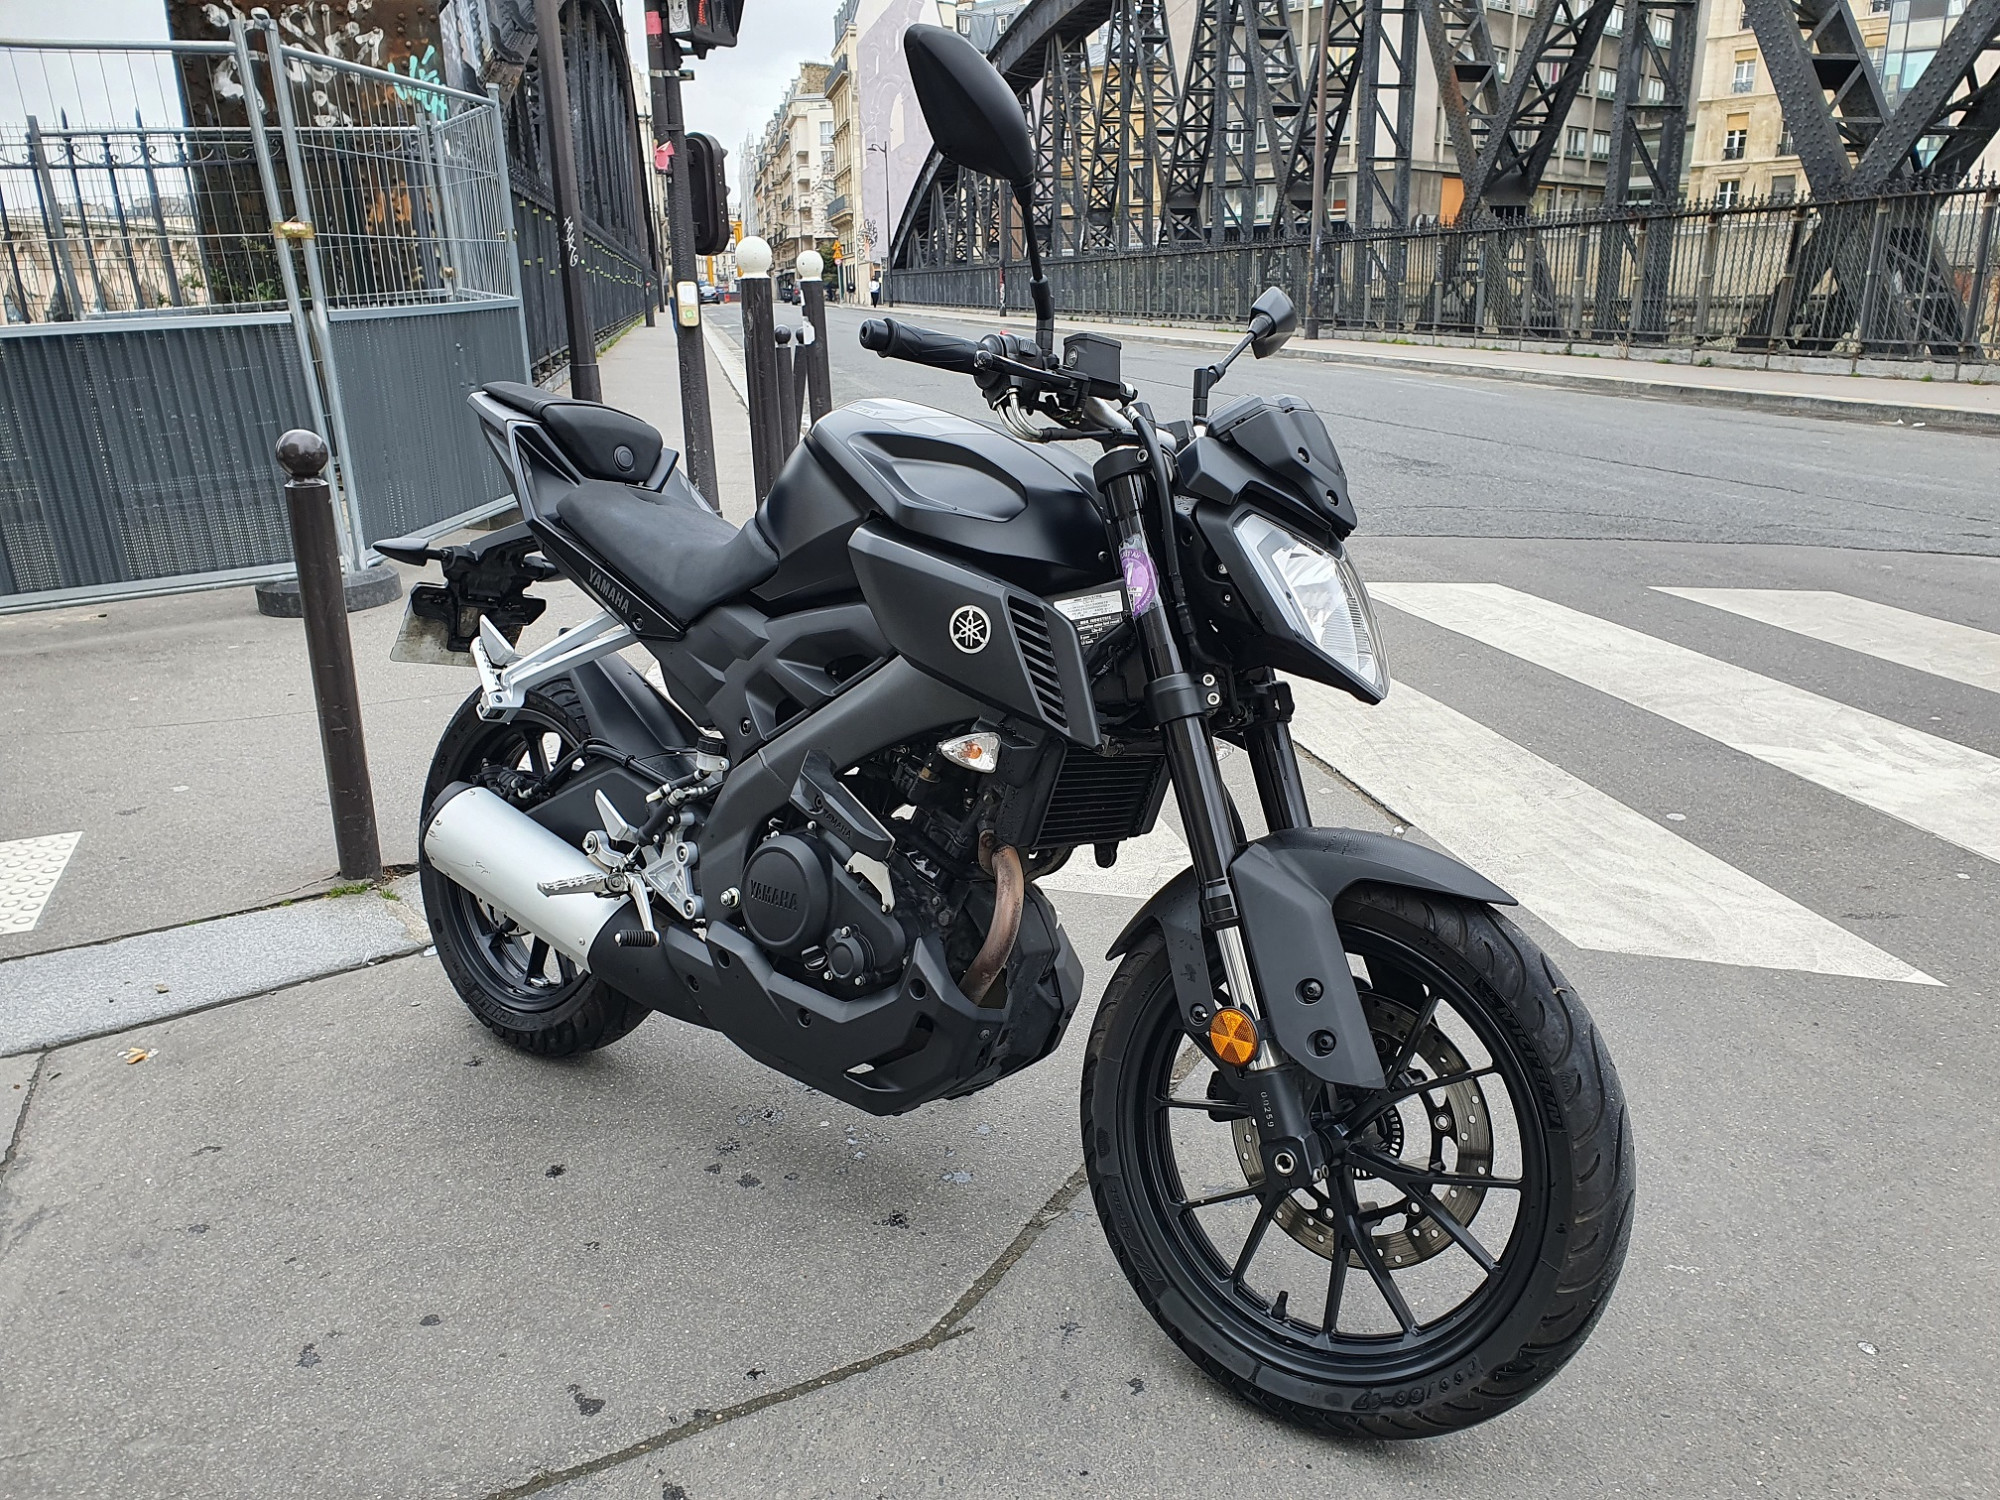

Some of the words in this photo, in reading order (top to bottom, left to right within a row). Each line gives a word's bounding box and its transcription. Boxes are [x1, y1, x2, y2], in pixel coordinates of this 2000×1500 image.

[589, 567, 629, 614] YAMAHA
[824, 809, 851, 839] YAMAHA
[751, 879, 797, 911] YAMAHA
[1496, 1004, 1563, 1129] MICHELIN
